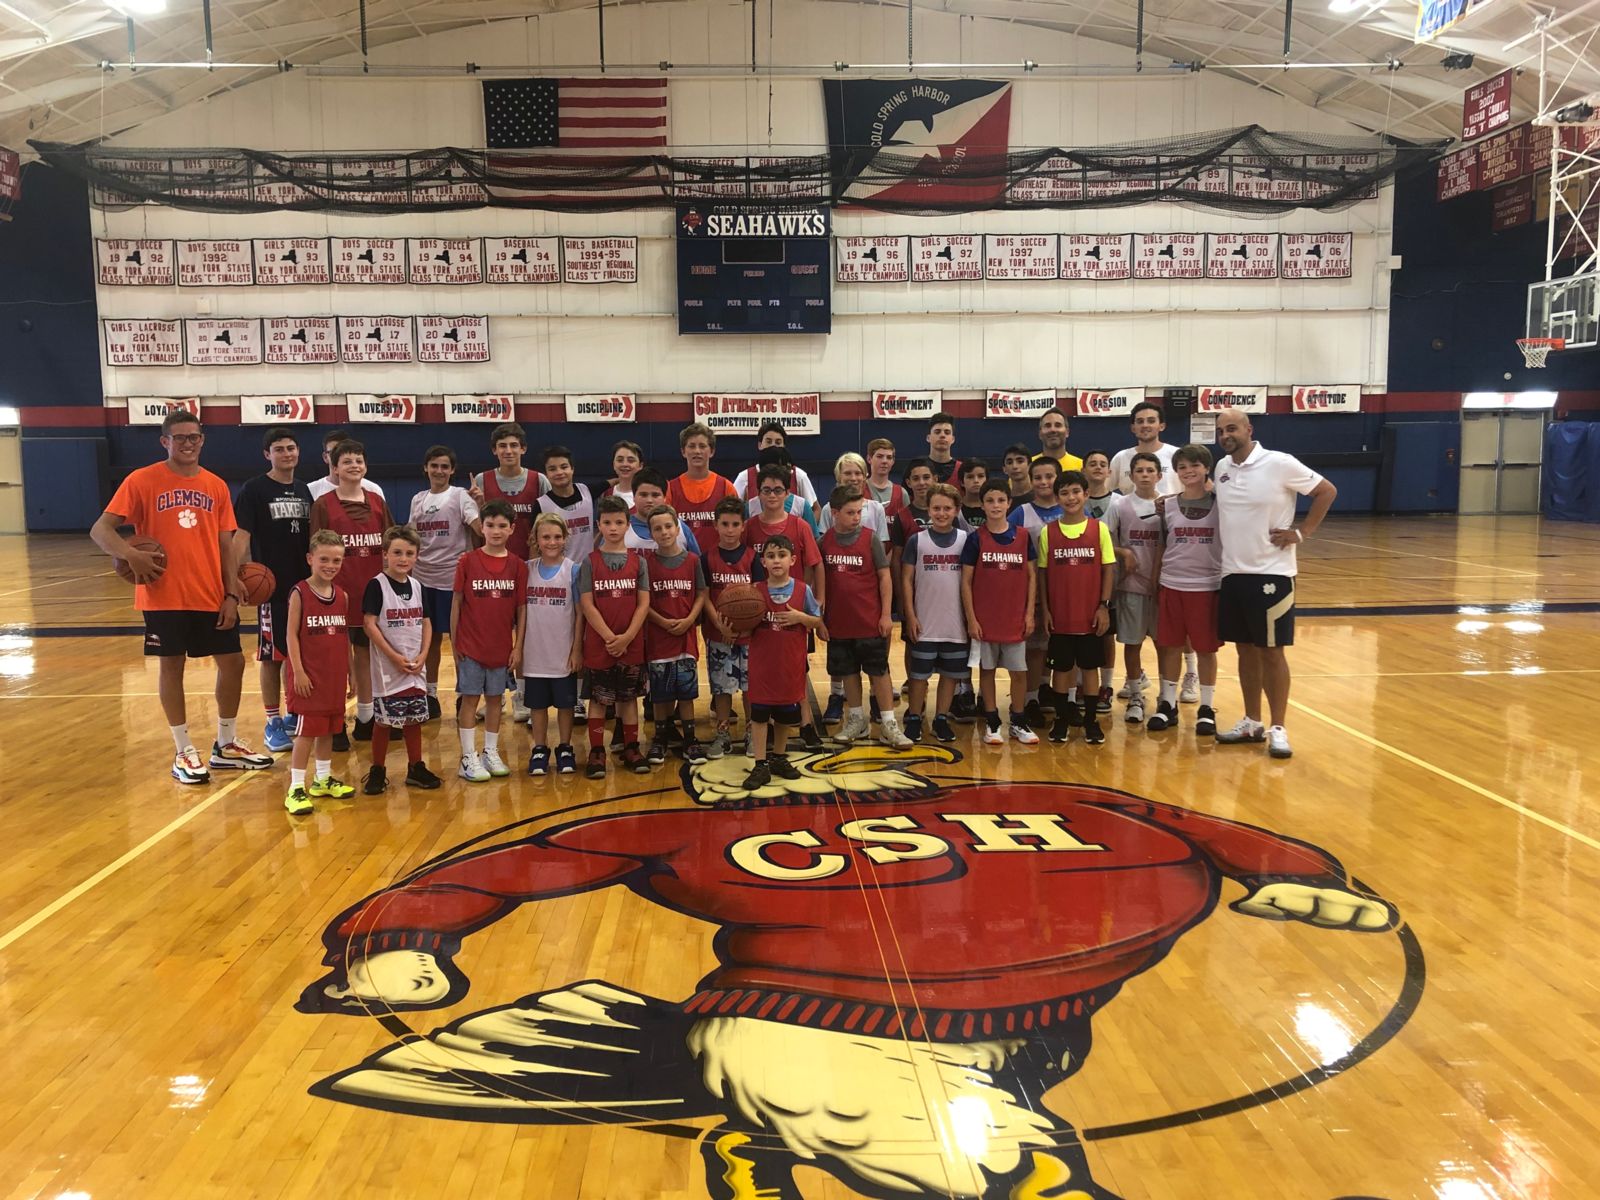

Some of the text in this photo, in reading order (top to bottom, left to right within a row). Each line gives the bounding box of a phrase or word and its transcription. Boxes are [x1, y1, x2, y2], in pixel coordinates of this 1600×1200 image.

[871, 85, 950, 147] COLD SPRING HARBOR
[1048, 160, 1073, 168] SOCCER
[1208, 170, 1219, 179] 89
[278, 186, 296, 194] YORK
[459, 186, 481, 194] STATE
[1236, 182, 1298, 190] NEW YORK STATE
[708, 215, 825, 236] SEAHAWKS
[504, 240, 540, 248] BASEBALL
[997, 238, 1046, 246] BOYS SOCCER
[1288, 235, 1344, 244] BOYS LACROSSE
[108, 242, 162, 250] GIRLS SOCCER
[188, 243, 240, 252] BOYS SOCCER
[566, 240, 634, 249] GIRLS BASKETBALL
[537, 252, 549, 260] 94
[581, 250, 620, 259] 1994-95
[1010, 248, 1032, 257] 1997
[1290, 248, 1301, 256] 20
[151, 254, 163, 262] 92
[203, 254, 227, 262] 1992
[988, 258, 1054, 266] NEW YORK STATE
[203, 264, 220, 272] YORK
[228, 264, 250, 272] STATE
[490, 264, 555, 273] NEW YORK STATE
[567, 260, 634, 270] SOUTHEAST REGIONAL
[1304, 260, 1320, 268] YORK
[125, 267, 142, 275] YORK
[148, 266, 170, 275] STATE
[1023, 268, 1055, 277] FINALISTS
[1284, 269, 1301, 277] CLASS
[1316, 268, 1349, 276] CHAMPIONS
[101, 275, 123, 283] CLASS
[181, 274, 202, 282] CLASS
[218, 274, 251, 282] FINALISTS
[489, 274, 508, 282] CLASS
[523, 273, 558, 282] CHAMPIONS
[568, 272, 588, 280] CLASS
[603, 271, 634, 279] FINALISTS
[111, 323, 175, 332] GIRLS LACROSSE
[133, 333, 156, 341] 2014
[111, 344, 179, 352] NEW YORK STATE
[114, 354, 133, 362] CLASS
[150, 354, 178, 362] FINALIST
[1093, 397, 1126, 408] PASSION
[1208, 394, 1256, 406] CONFIDENCE
[1307, 394, 1346, 404] ATTITUDE
[360, 403, 403, 413] ADVERSITY
[452, 403, 507, 414] PREPARATION
[578, 402, 623, 414] DISCIPLINE
[696, 396, 818, 416] CSH ATHLETIC VISION
[880, 399, 933, 410] COMMITMENT
[988, 398, 1054, 410] SPORTSMANSHIP
[265, 404, 290, 415] PRIDE
[708, 417, 759, 427] COMPETITIVE
[157, 489, 214, 512] CLEMSON
[678, 511, 715, 521] SEAHAWKS
[342, 533, 382, 547] EAHAWKS
[982, 552, 1023, 563] SEAHAWKS
[1054, 548, 1095, 558] SEAHAWKS
[826, 554, 863, 565] SEAHAWKS
[712, 572, 750, 583] SEAHAWKS
[472, 580, 515, 590] SEAHAWKS
[594, 578, 636, 590] SEAHAWKS
[653, 580, 692, 591] SEAHAWKS
[307, 616, 346, 627] SEAHAWKS
[730, 812, 1105, 880] CSH
